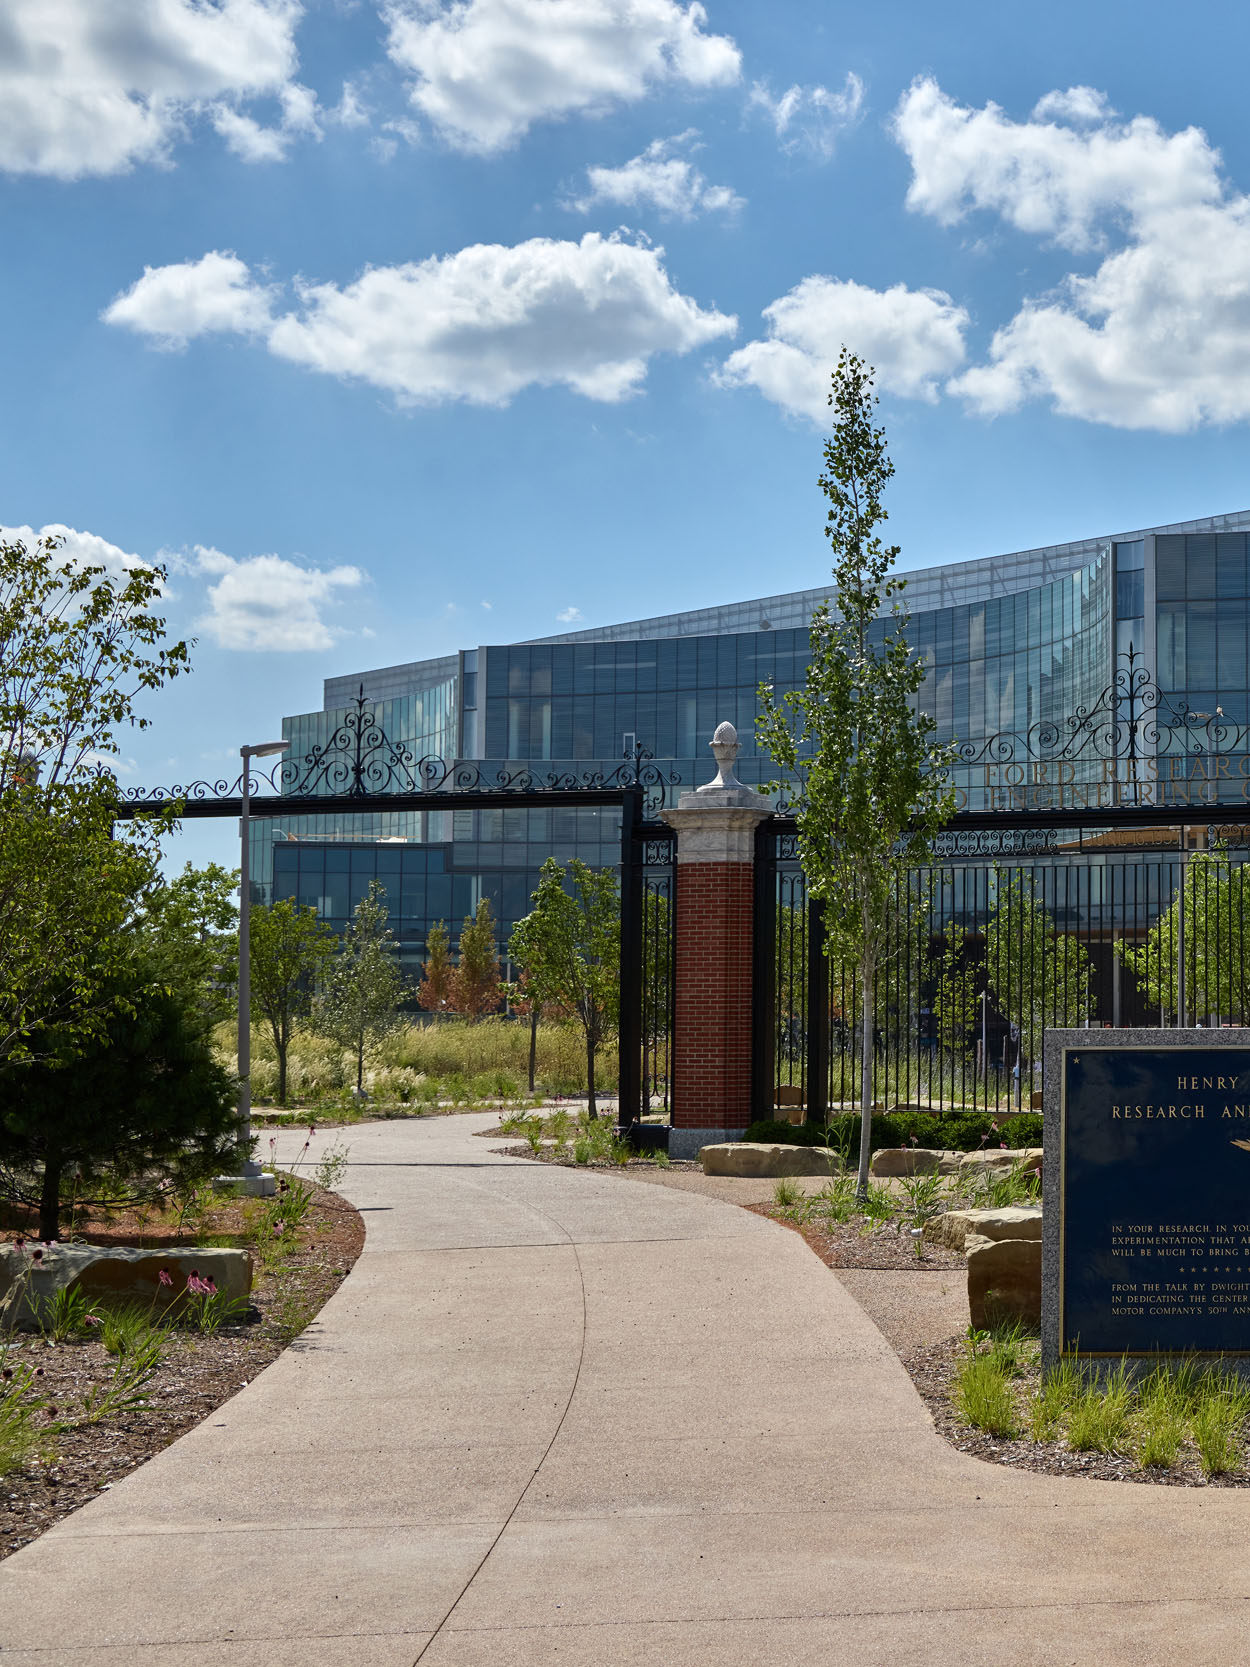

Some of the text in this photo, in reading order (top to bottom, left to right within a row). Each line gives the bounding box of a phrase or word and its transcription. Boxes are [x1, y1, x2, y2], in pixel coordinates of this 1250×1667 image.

[985, 762, 1076, 787] FORD
[990, 782, 1218, 810] ENGINEERING
[1177, 1076, 1239, 1090] HENRY
[1112, 1105, 1205, 1119] RESEARCH
[1112, 1225, 1123, 1233] IN
[1127, 1225, 1153, 1233] YOUR
[1216, 1224, 1227, 1233] IN
[1111, 1236, 1205, 1245] EXPERIMENTATION
[1210, 1236, 1236, 1245] THAT
[1111, 1248, 1135, 1257] WILL
[1140, 1248, 1152, 1257] BE
[1157, 1248, 1186, 1257] MUCH
[1190, 1248, 1204, 1256] TO
[1209, 1248, 1239, 1256] BRING
[1111, 1283, 1137, 1292] FROM
[1141, 1283, 1160, 1292] THE
[1165, 1283, 1188, 1292] TALK
[1193, 1283, 1206, 1291] BY
[1211, 1282, 1250, 1291] DWIGHT
[1111, 1295, 1122, 1304] IN
[1127, 1295, 1184, 1303] DEDICATING
[1188, 1295, 1207, 1303] THE
[1212, 1294, 1248, 1303] CENTER
[1111, 1307, 1145, 1315] MOTOR
